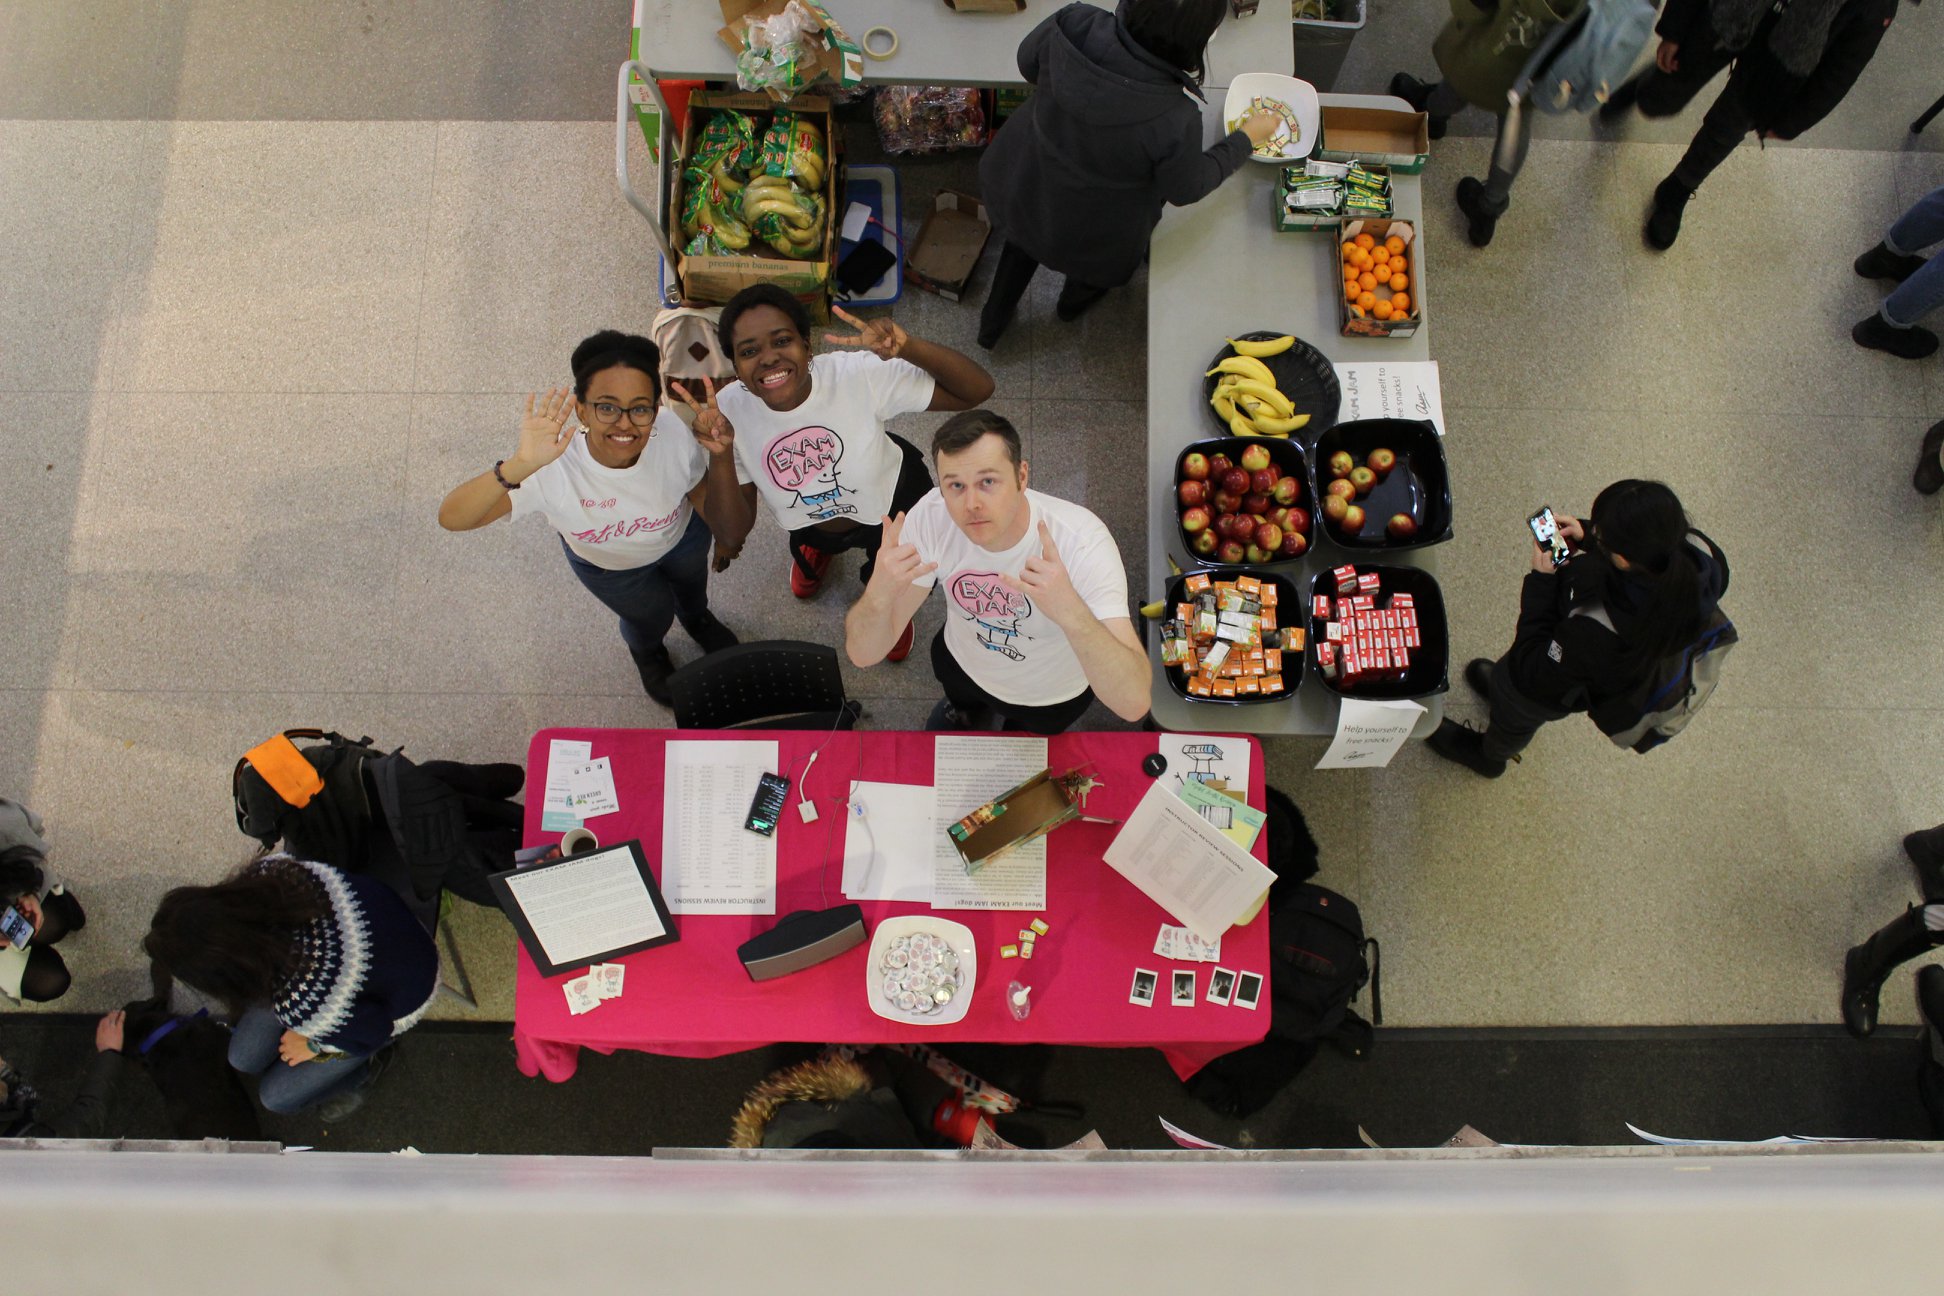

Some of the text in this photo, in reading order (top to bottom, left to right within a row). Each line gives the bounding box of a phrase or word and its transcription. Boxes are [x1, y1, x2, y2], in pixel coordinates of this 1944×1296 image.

[708, 260, 788, 270] premium bananas
[1378, 367, 1386, 377] to
[1347, 370, 1361, 420] XAM JAM
[1377, 377, 1390, 412] yourself
[1392, 375, 1404, 406] snacks!
[770, 433, 835, 473] EXAM
[787, 451, 835, 487] JAM
[571, 505, 681, 544] Arts & Scienc
[1343, 724, 1363, 733] Help
[1364, 726, 1398, 734] yourself
[1165, 807, 1244, 872] INSTRUCTOR REVIEW SESSIONS
[674, 897, 766, 905] INSTRUCTOR REVIEW SESSIONS
[954, 899, 973, 907] dogs!
